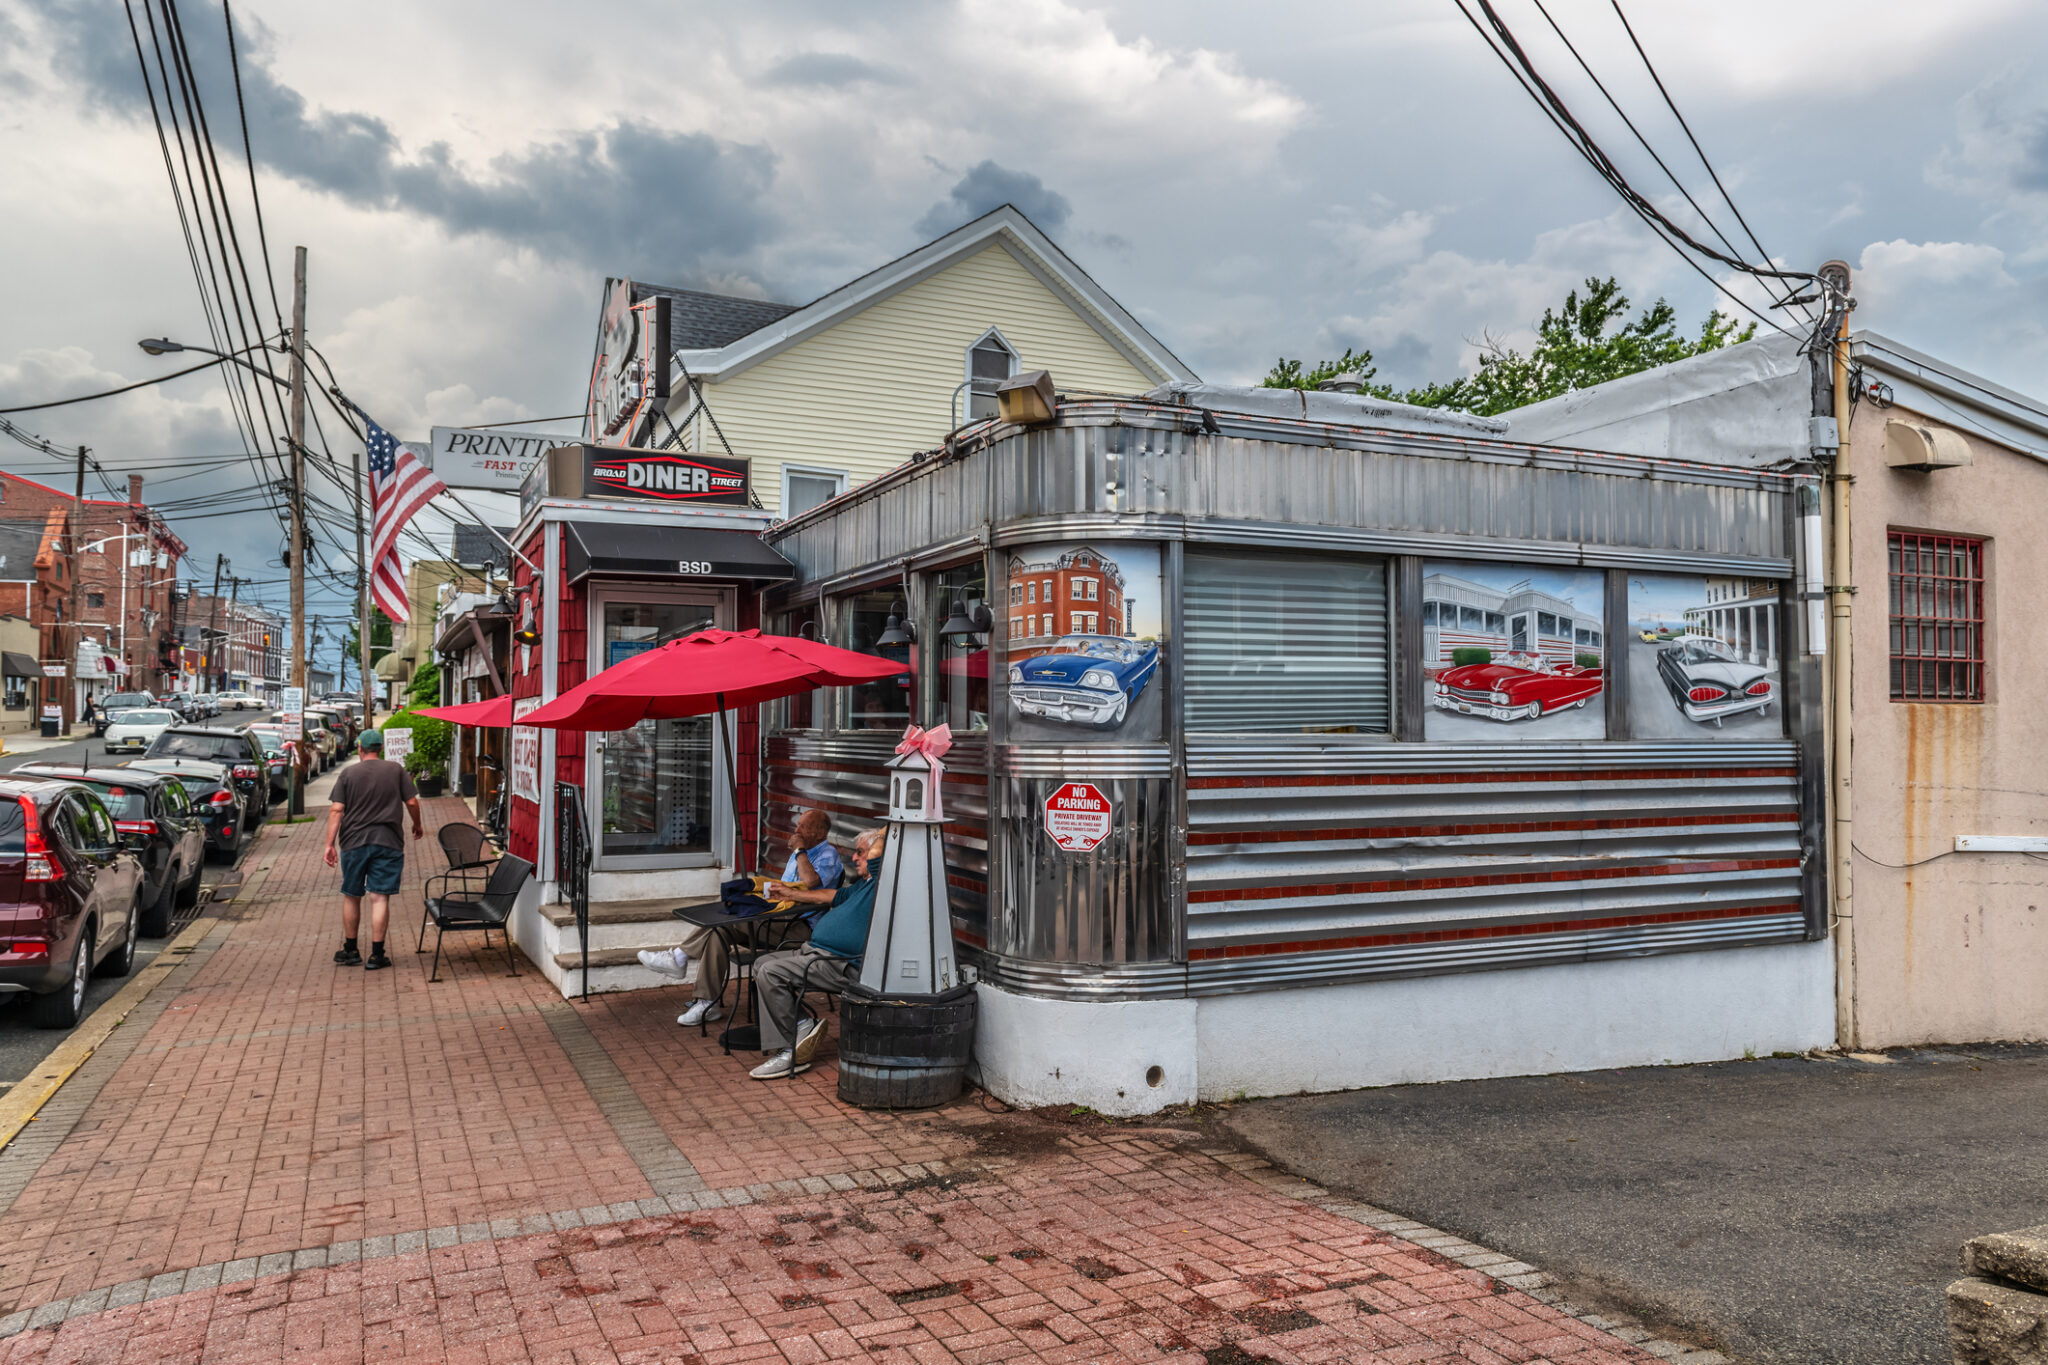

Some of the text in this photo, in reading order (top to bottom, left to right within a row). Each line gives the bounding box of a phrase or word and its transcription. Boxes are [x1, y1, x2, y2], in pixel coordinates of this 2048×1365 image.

[445, 433, 584, 458] PRINTI
[484, 460, 517, 471] FAST
[495, 470, 521, 480] Printing
[593, 462, 743, 493] BROAD DINER STREET
[679, 561, 712, 574] BSD
[386, 737, 410, 747] FIRST
[389, 747, 409, 756] WOK
[1072, 786, 1086, 798] NO
[1057, 798, 1100, 810] PARKING
